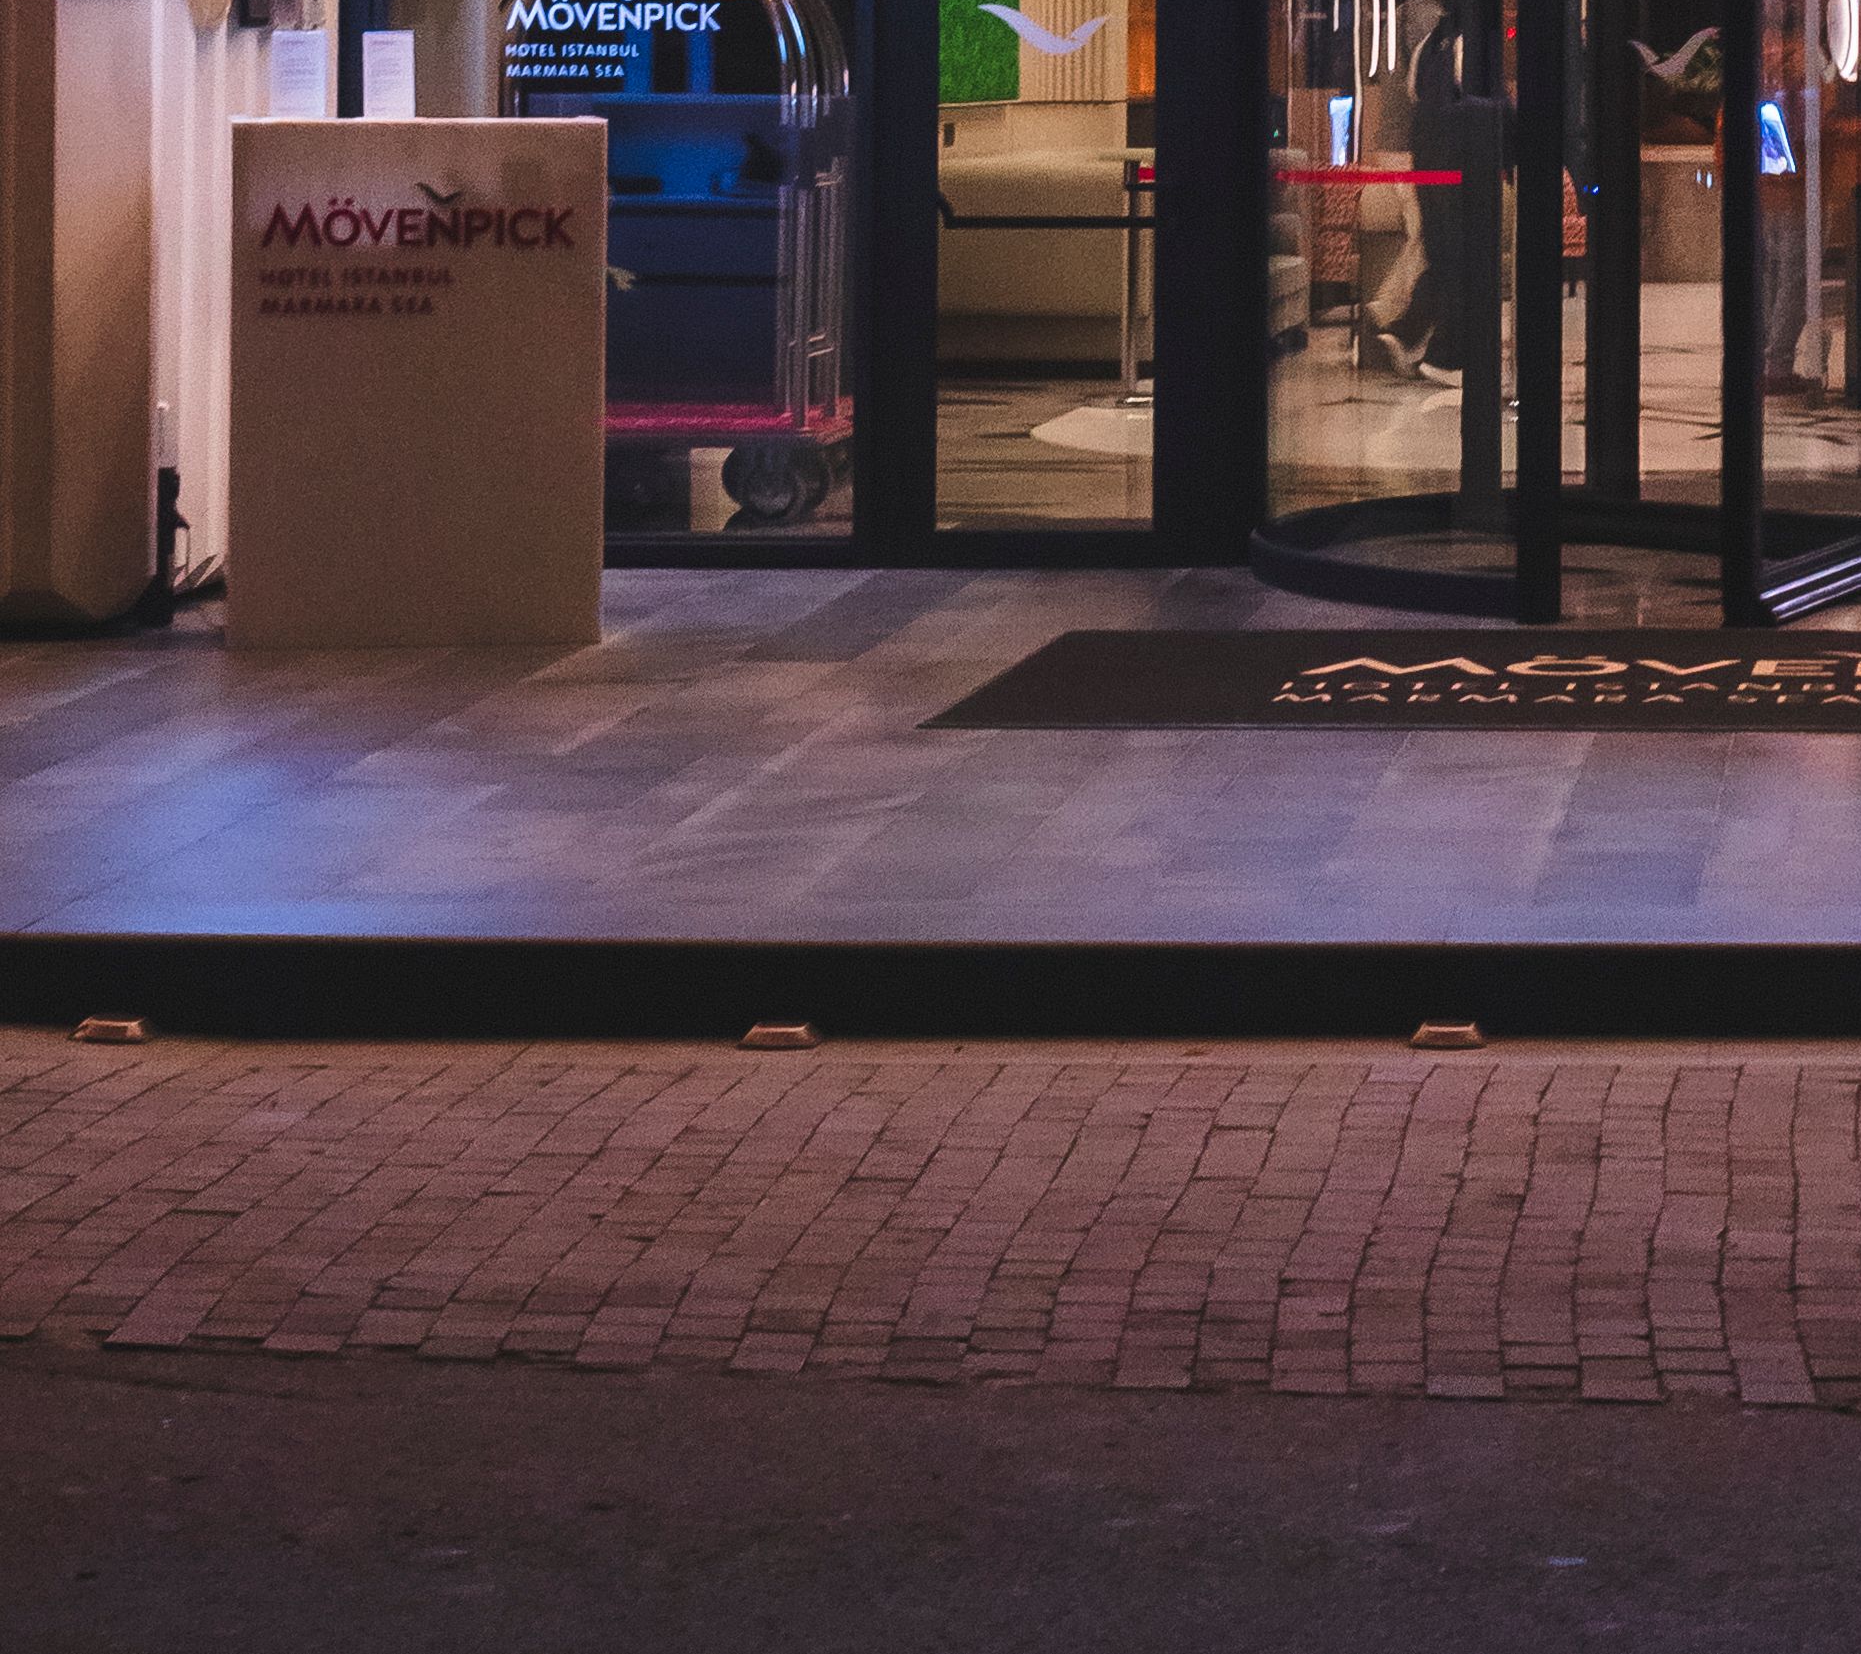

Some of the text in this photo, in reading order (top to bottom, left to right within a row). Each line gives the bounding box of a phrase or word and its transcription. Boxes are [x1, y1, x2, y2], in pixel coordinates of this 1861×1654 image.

[505, 43, 640, 57] HOTEL ISTANBUL
[506, 63, 625, 78] MARMARA SEA
[262, 197, 576, 248] MÖVENPICK
